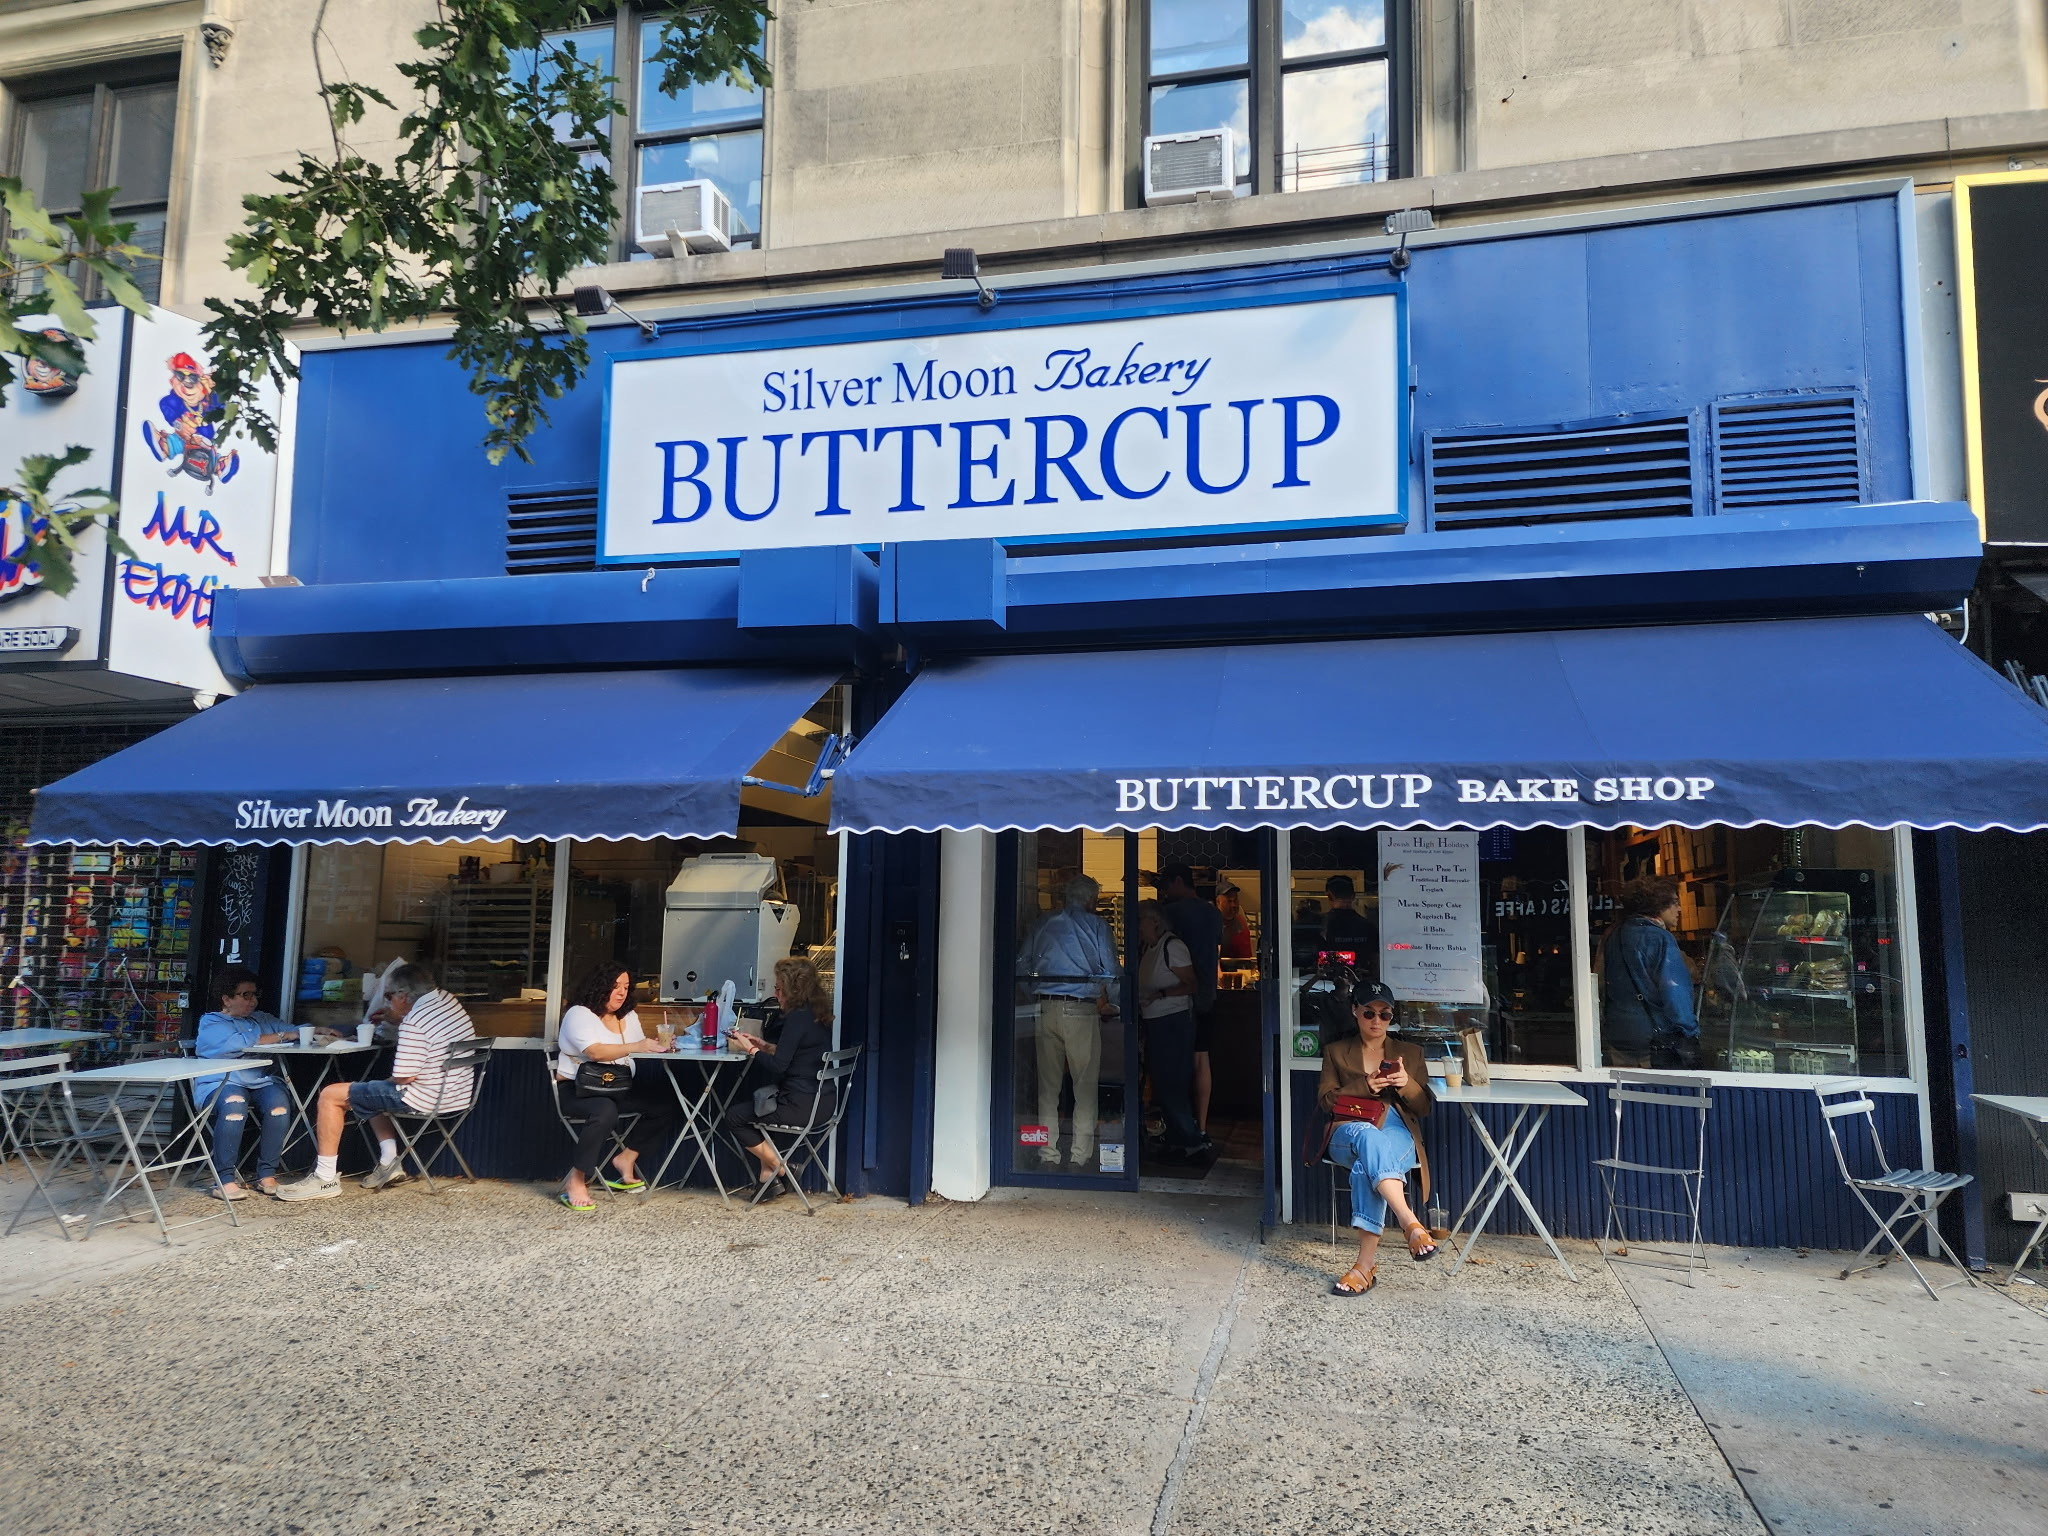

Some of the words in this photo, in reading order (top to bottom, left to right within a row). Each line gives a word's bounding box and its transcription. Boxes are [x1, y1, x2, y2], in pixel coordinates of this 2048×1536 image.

[762, 367, 882, 414] Silver
[891, 359, 1018, 404] Moon
[1033, 341, 1212, 397] Bakery
[651, 394, 1341, 525] BUTTERCUP
[21, 629, 56, 648] SODA
[1115, 773, 1433, 812] BUTTERCUP
[1457, 778, 1579, 803] BAKE
[1593, 777, 1715, 801] SHOP
[235, 799, 313, 830] Silver
[313, 799, 394, 829] Moon
[399, 796, 508, 832] Bakery
[1413, 837, 1435, 850] High
[1438, 837, 1470, 849] Holidays
[1020, 1129, 1048, 1143] eats
[320, 1181, 338, 1191] HOKA
